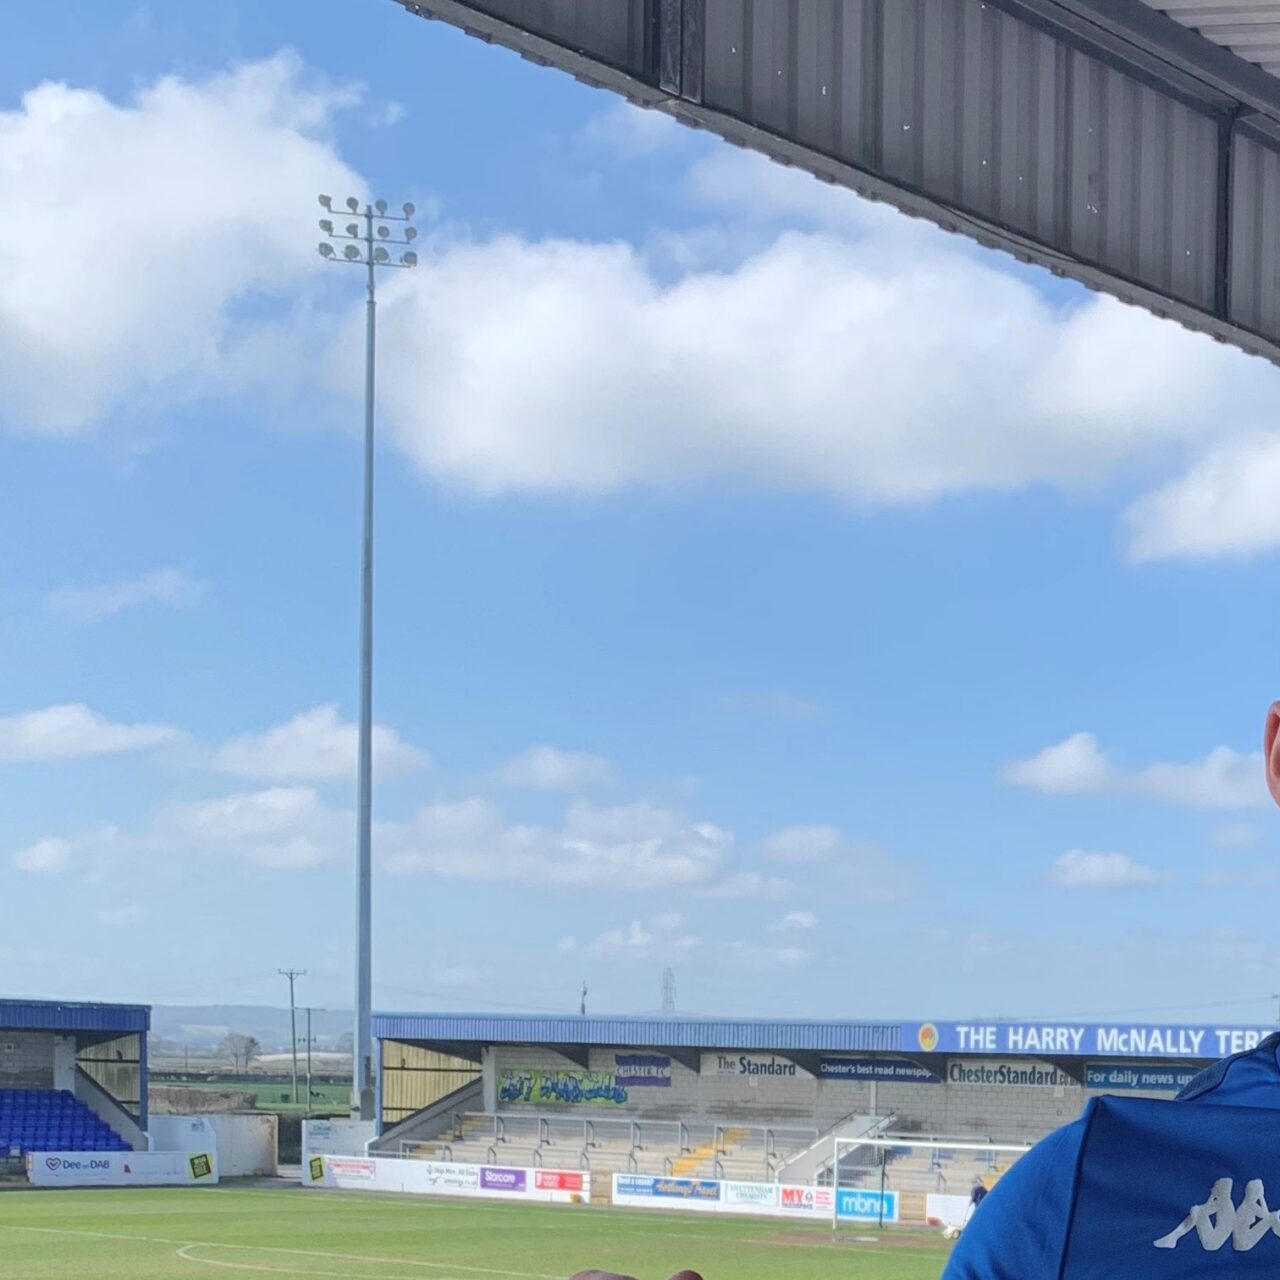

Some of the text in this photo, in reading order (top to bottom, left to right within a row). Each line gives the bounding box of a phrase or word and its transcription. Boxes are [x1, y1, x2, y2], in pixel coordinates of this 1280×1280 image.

[956, 1026, 997, 1050] THE
[1008, 1027, 1085, 1051] HARRY
[1097, 1028, 1206, 1054] McNALLY
[717, 1055, 797, 1076] The Standard
[820, 1062, 854, 1074] Chester's
[856, 1064, 873, 1075] best
[874, 1065, 894, 1076] read
[1087, 1070, 1105, 1083] For
[1109, 1070, 1139, 1087] daily
[1142, 1073, 1174, 1084] news
[842, 1194, 888, 1214] mbna
